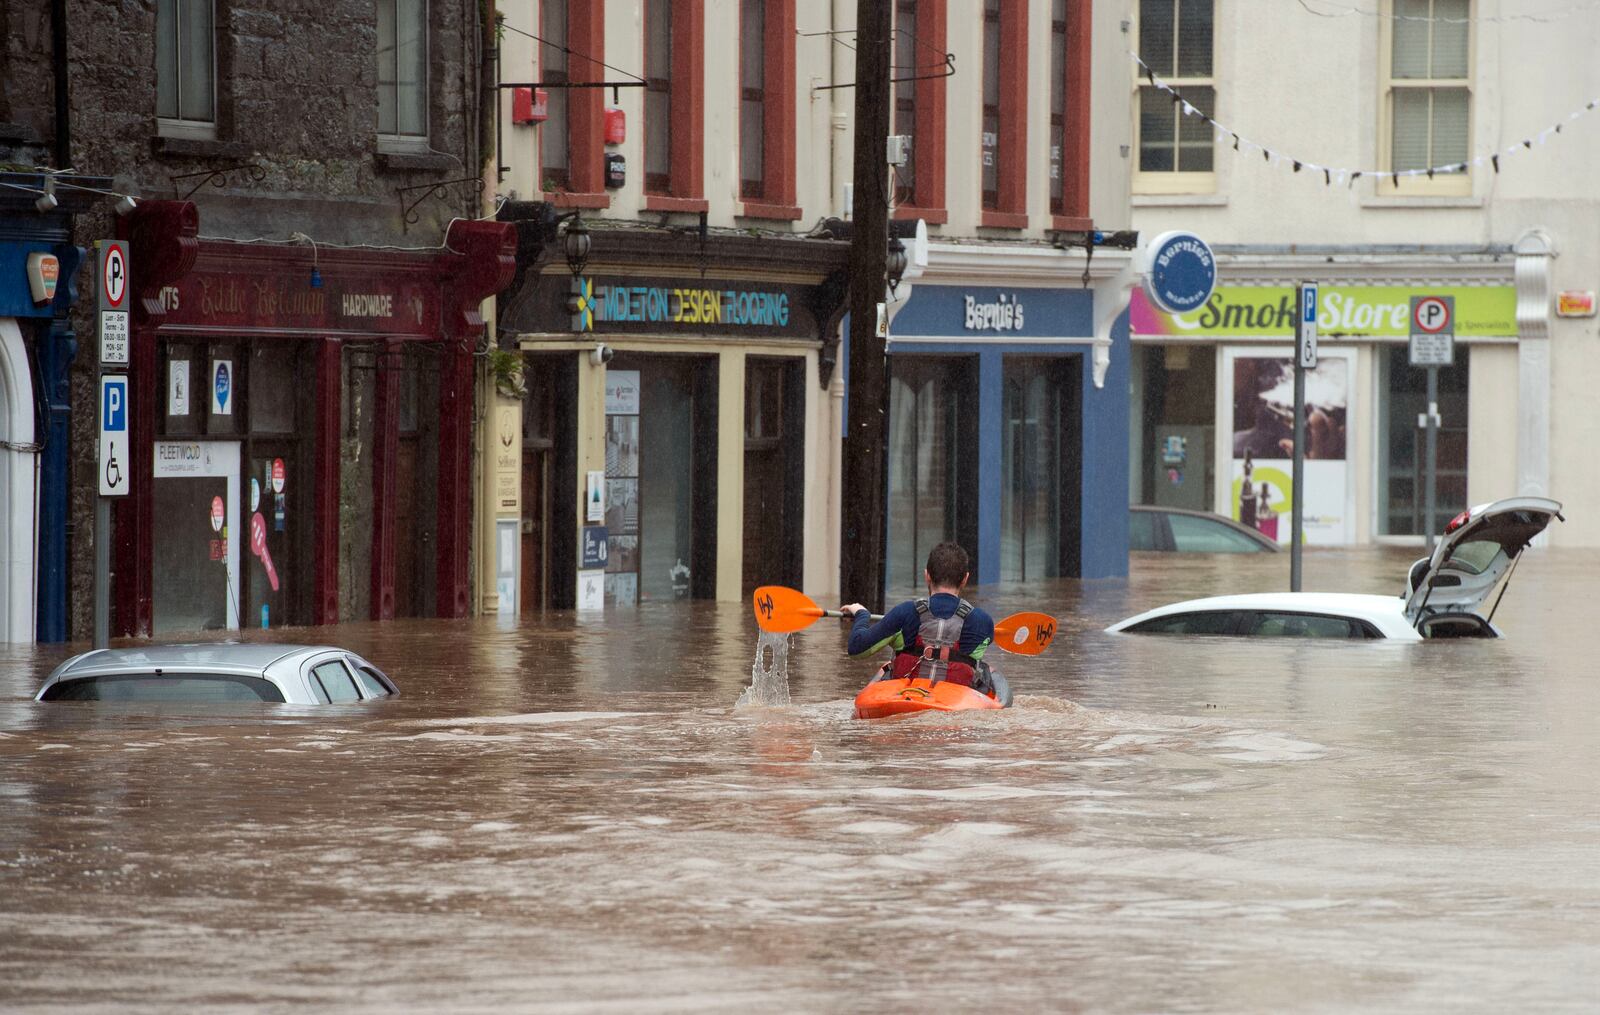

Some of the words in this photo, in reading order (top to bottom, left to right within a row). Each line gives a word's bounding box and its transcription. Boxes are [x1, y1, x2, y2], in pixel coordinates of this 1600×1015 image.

[1158, 241, 1211, 268] Bernie's
[111, 257, 120, 294] P
[342, 293, 393, 318] HARDWARE
[674, 288, 720, 324] DESIGN
[726, 290, 788, 326] FLOORING
[965, 294, 1024, 331] Bernie's
[1199, 292, 1297, 330] Smok
[1319, 291, 1409, 331] Store
[1306, 291, 1313, 319] P
[1428, 304, 1440, 325] P
[109, 387, 121, 426] P
[159, 445, 201, 460] FLEETWOOD
[757, 594, 774, 619] H2O
[1036, 623, 1053, 646] H2O
